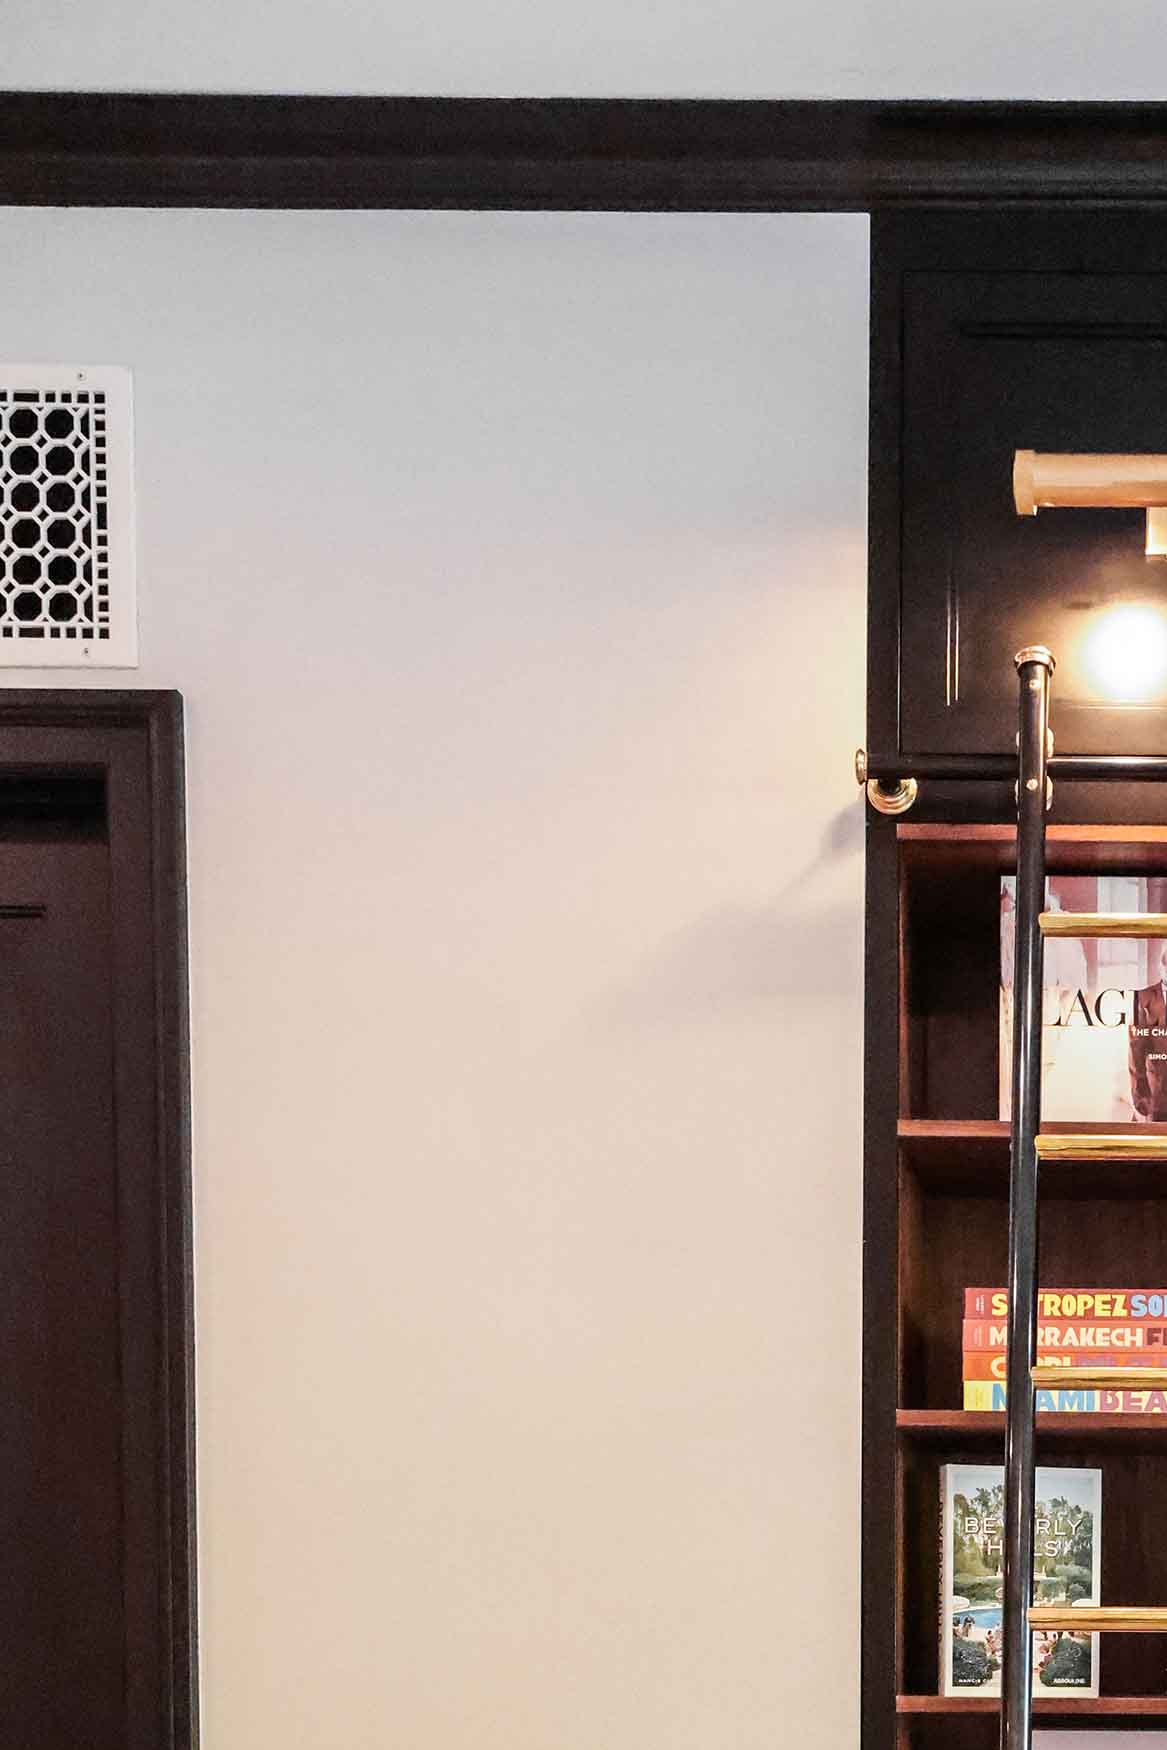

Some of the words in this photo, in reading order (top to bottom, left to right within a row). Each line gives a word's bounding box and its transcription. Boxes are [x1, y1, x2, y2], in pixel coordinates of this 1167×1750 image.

[1131, 1028, 1149, 1036] THE
[1037, 1293, 1126, 1317] ROPEZ
[989, 1325, 1143, 1347] MRAKECH
[991, 1383, 1096, 1412] MAMI
[964, 1516, 1082, 1536] BERLY
